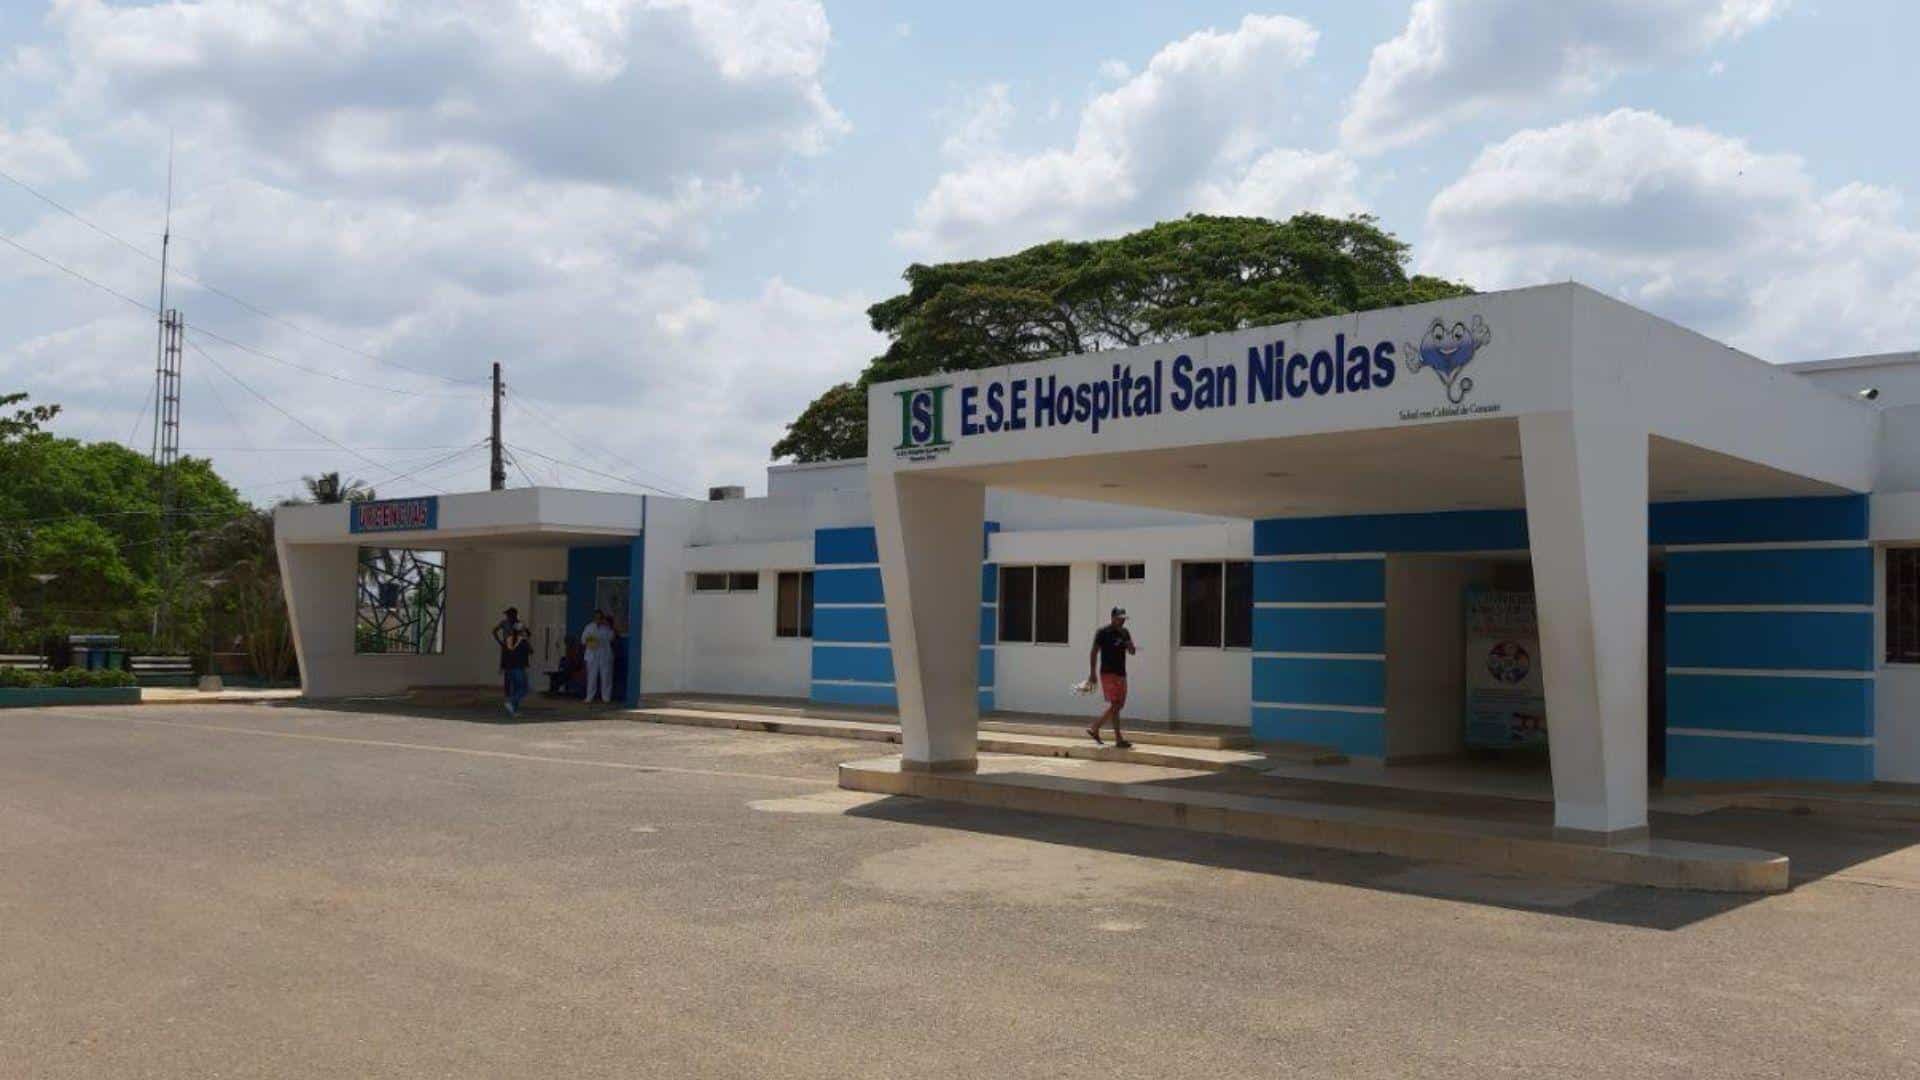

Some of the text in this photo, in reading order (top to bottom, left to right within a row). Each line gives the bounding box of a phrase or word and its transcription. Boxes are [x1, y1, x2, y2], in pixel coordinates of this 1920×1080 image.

[961, 332, 1397, 436] E.S.E Hospital San Nicolas
